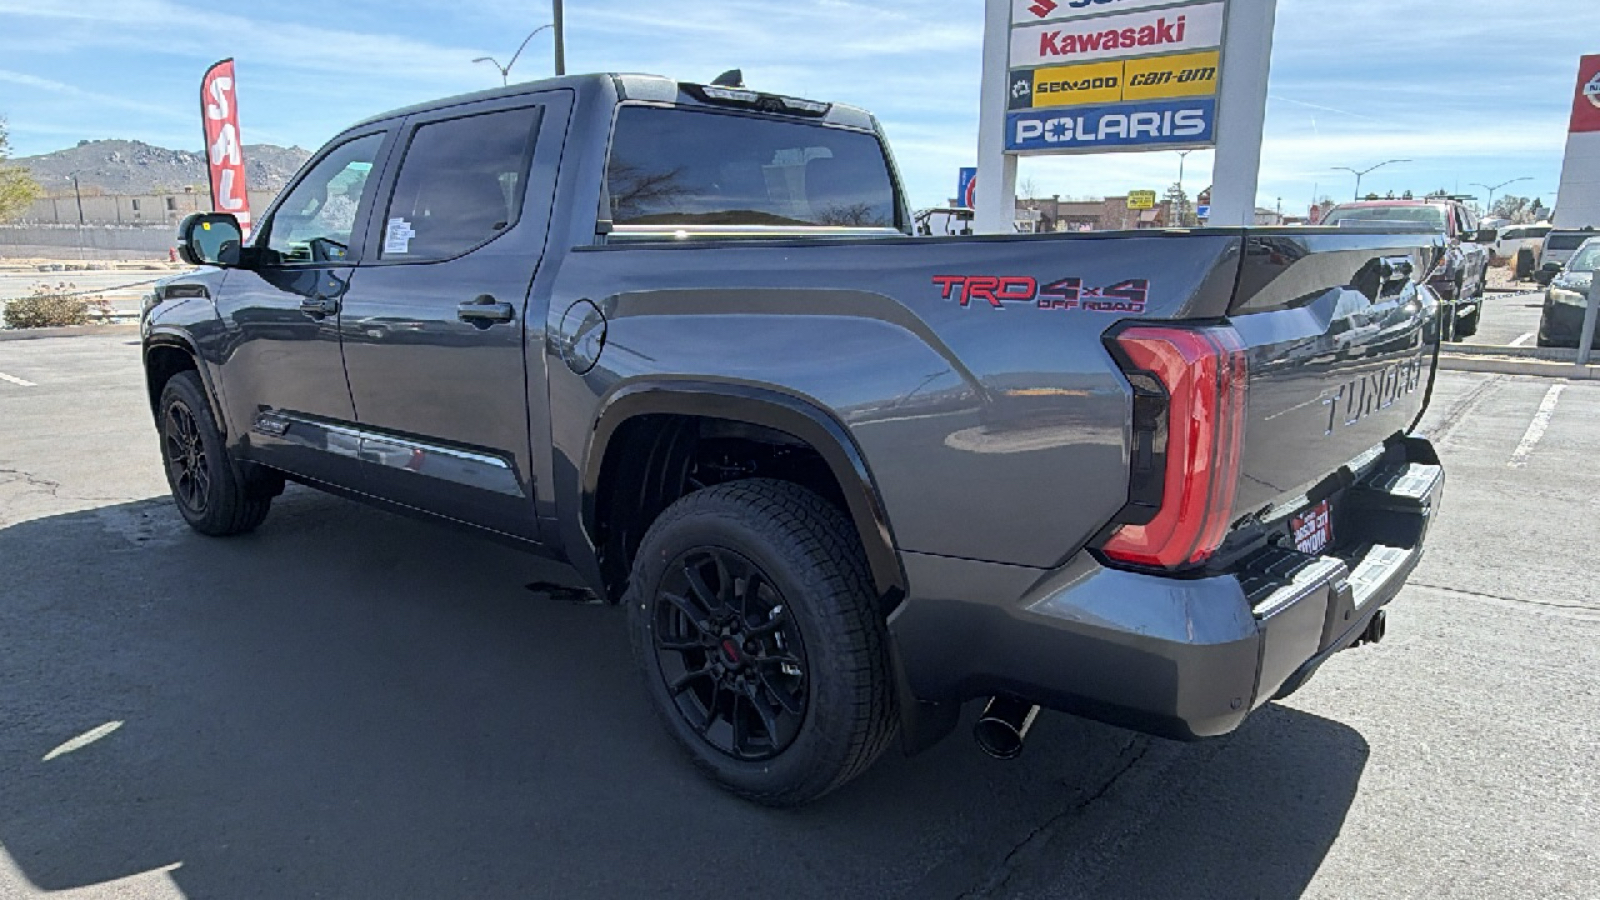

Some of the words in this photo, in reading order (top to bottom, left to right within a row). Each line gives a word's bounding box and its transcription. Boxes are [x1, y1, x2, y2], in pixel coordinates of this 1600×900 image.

[1039, 15, 1186, 56] Kawasaki
[1015, 109, 1205, 144] POLARIS
[931, 275, 1037, 309] TRD
[1038, 277, 1148, 302] 4x4
[1037, 299, 1082, 309] OFF
[1083, 301, 1146, 313] ROAD
